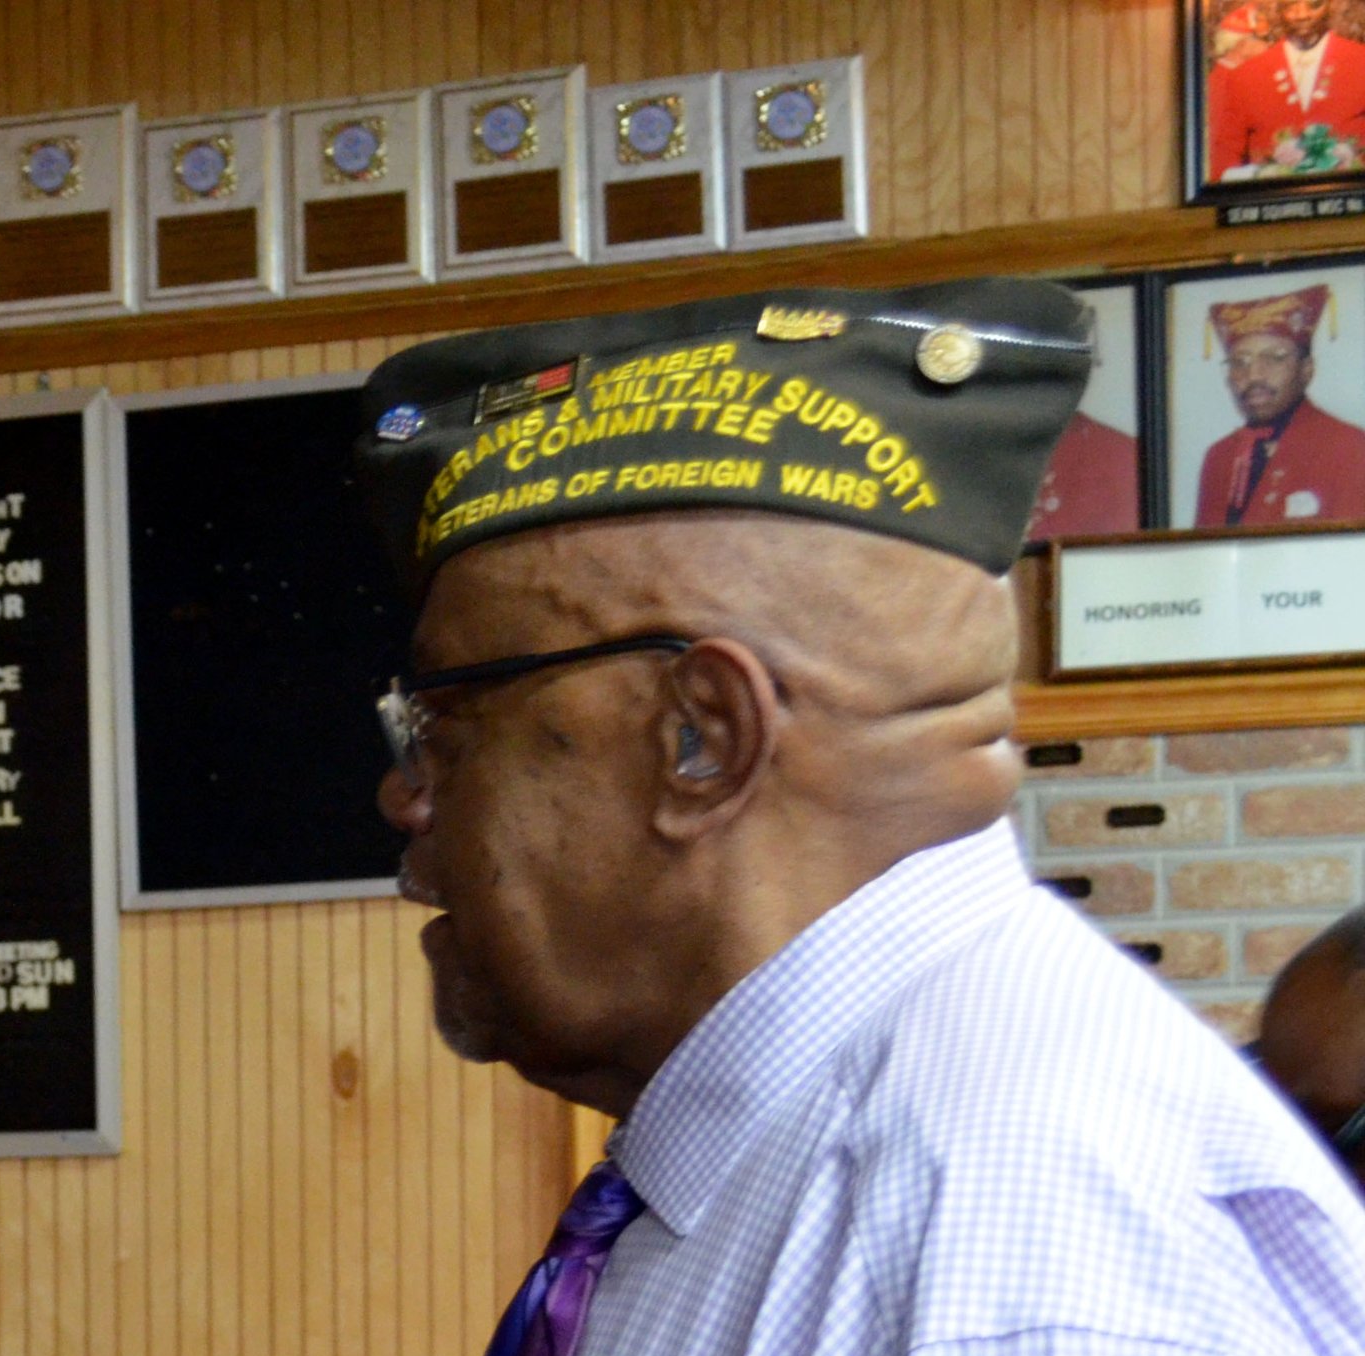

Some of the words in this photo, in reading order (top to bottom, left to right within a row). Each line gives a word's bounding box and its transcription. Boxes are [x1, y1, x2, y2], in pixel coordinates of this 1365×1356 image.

[505, 402, 782, 471] COMMITTEE
[592, 368, 771, 414] MILITARY
[773, 378, 936, 513] SUPPORT
[565, 469, 610, 500] OF
[615, 458, 762, 492] FOREIGN
[780, 464, 880, 510] WARS
[1085, 598, 1201, 623] HONORING
[1261, 590, 1323, 609] YOUR
[17, 960, 74, 984] SUN
